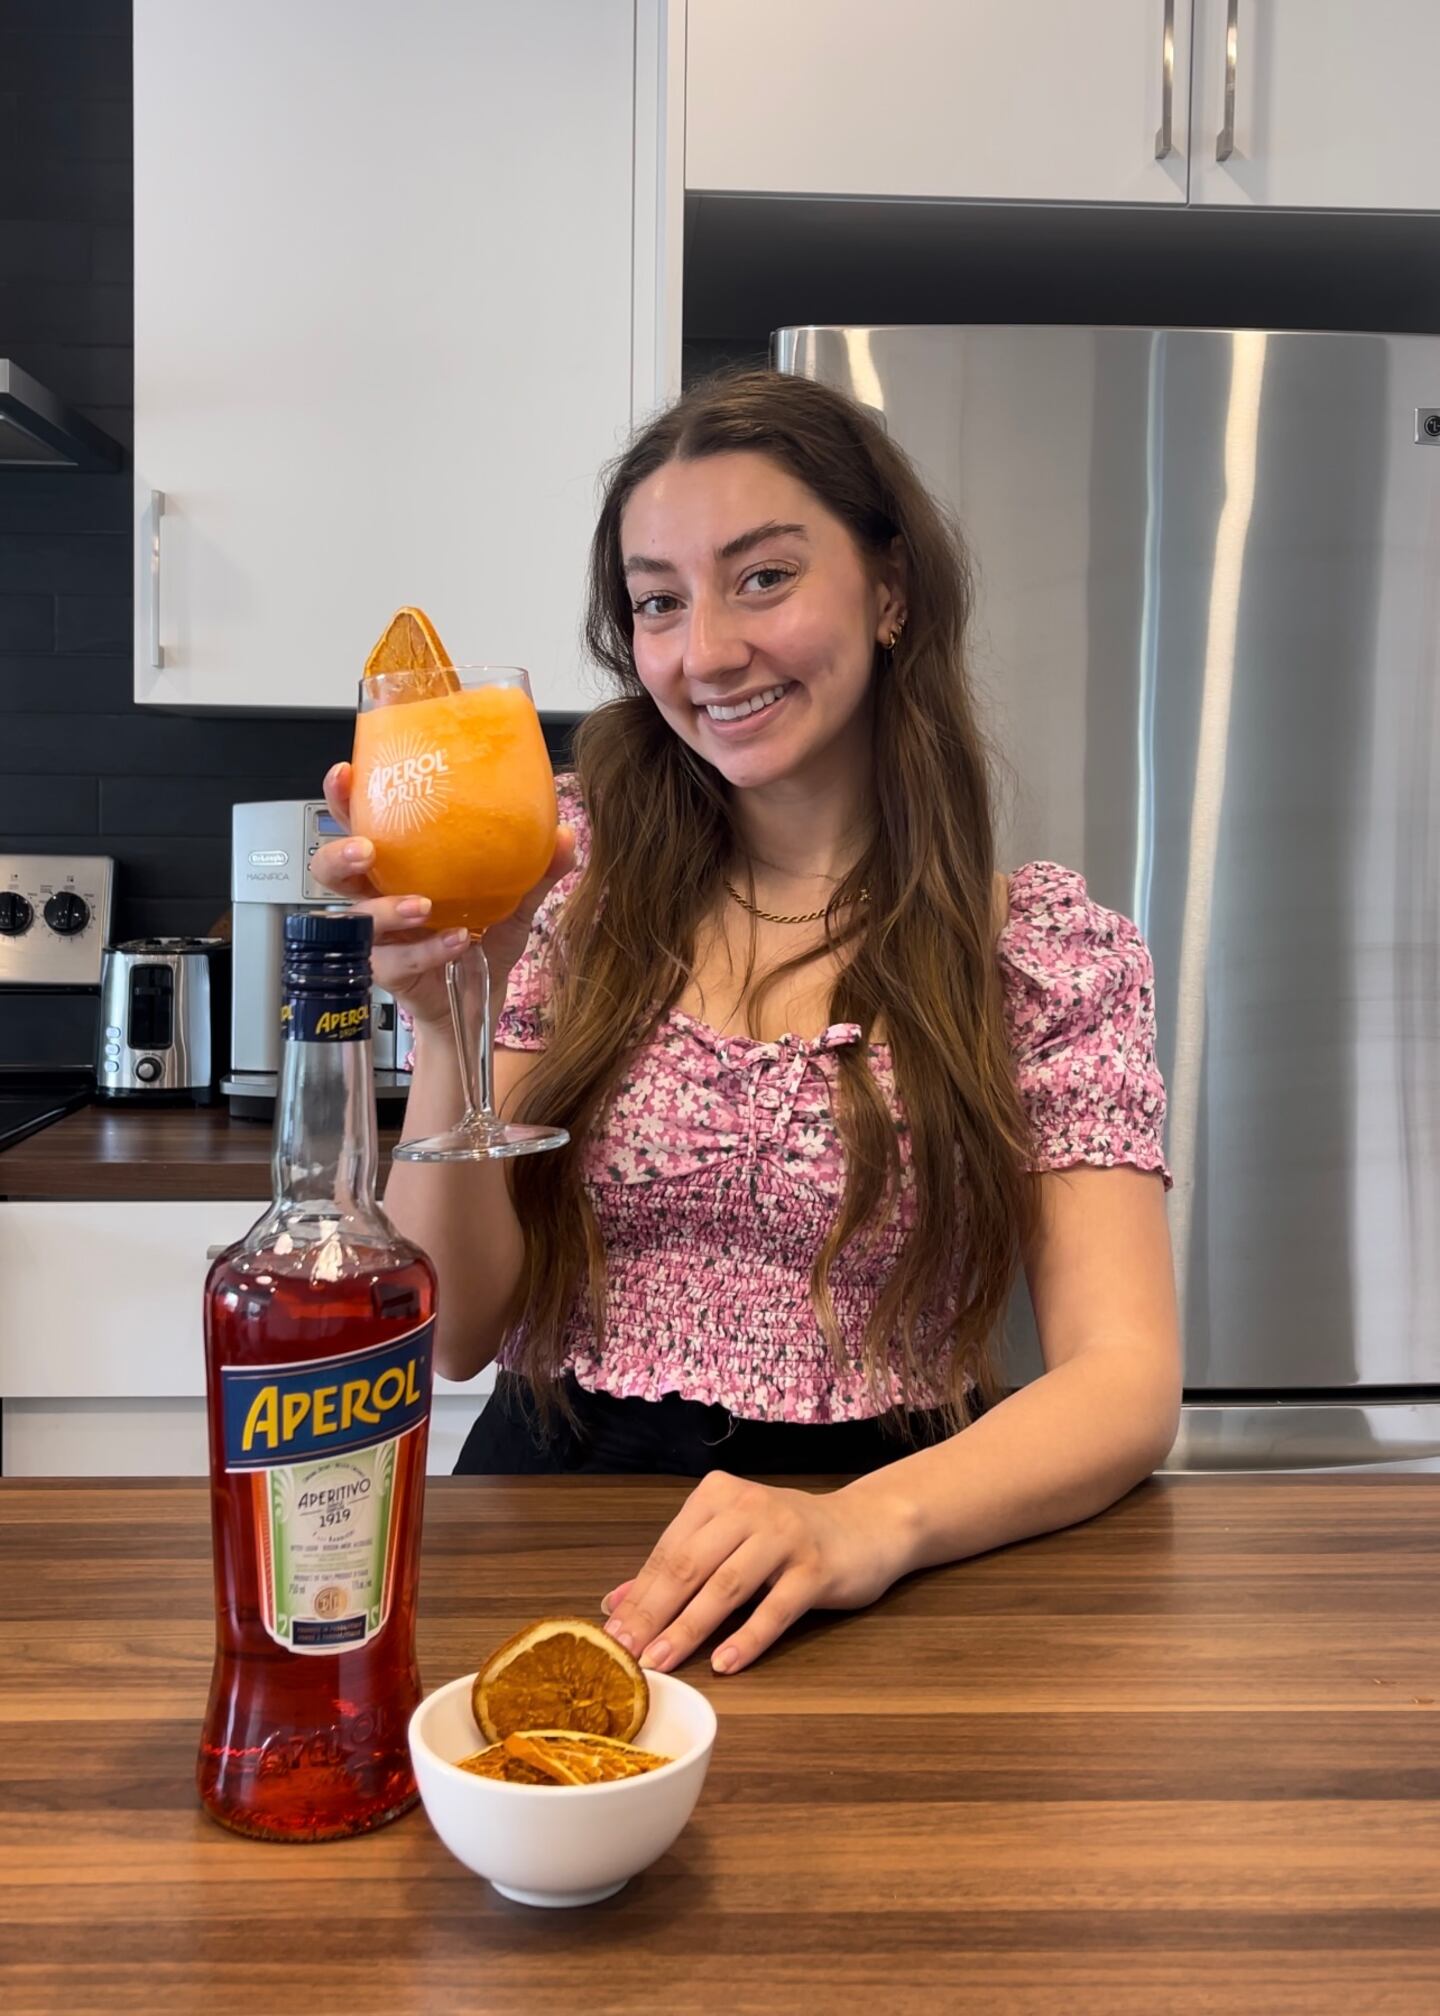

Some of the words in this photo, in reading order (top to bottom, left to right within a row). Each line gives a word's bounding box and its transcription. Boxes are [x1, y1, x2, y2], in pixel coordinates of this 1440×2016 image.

[367, 749, 448, 800] APEROL
[242, 1359, 420, 1451] APEROL
[298, 1478, 371, 1509] APERITIVO
[320, 1508, 351, 1528] 1919
